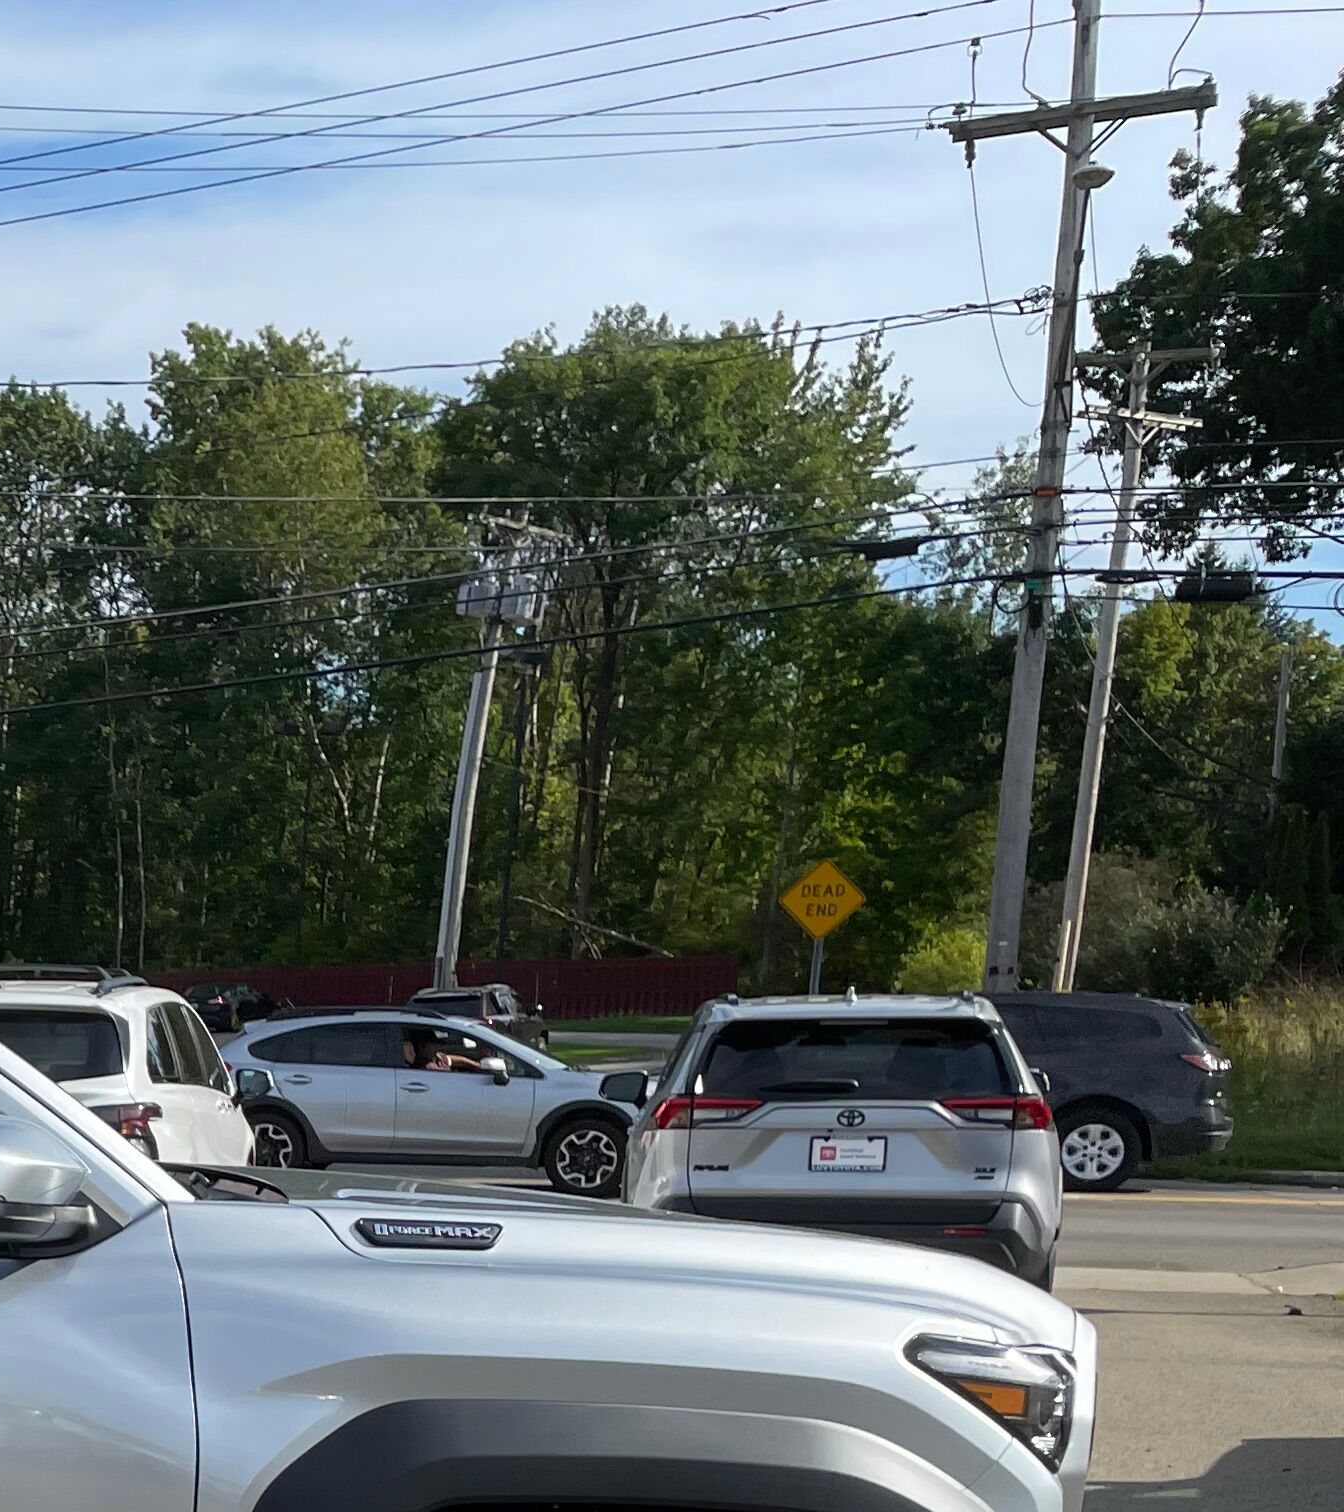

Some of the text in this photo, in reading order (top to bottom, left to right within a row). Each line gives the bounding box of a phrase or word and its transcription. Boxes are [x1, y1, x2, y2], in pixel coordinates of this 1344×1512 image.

[801, 883, 846, 898] DEAD
[806, 903, 838, 917] END
[434, 1224, 493, 1240] MAX
